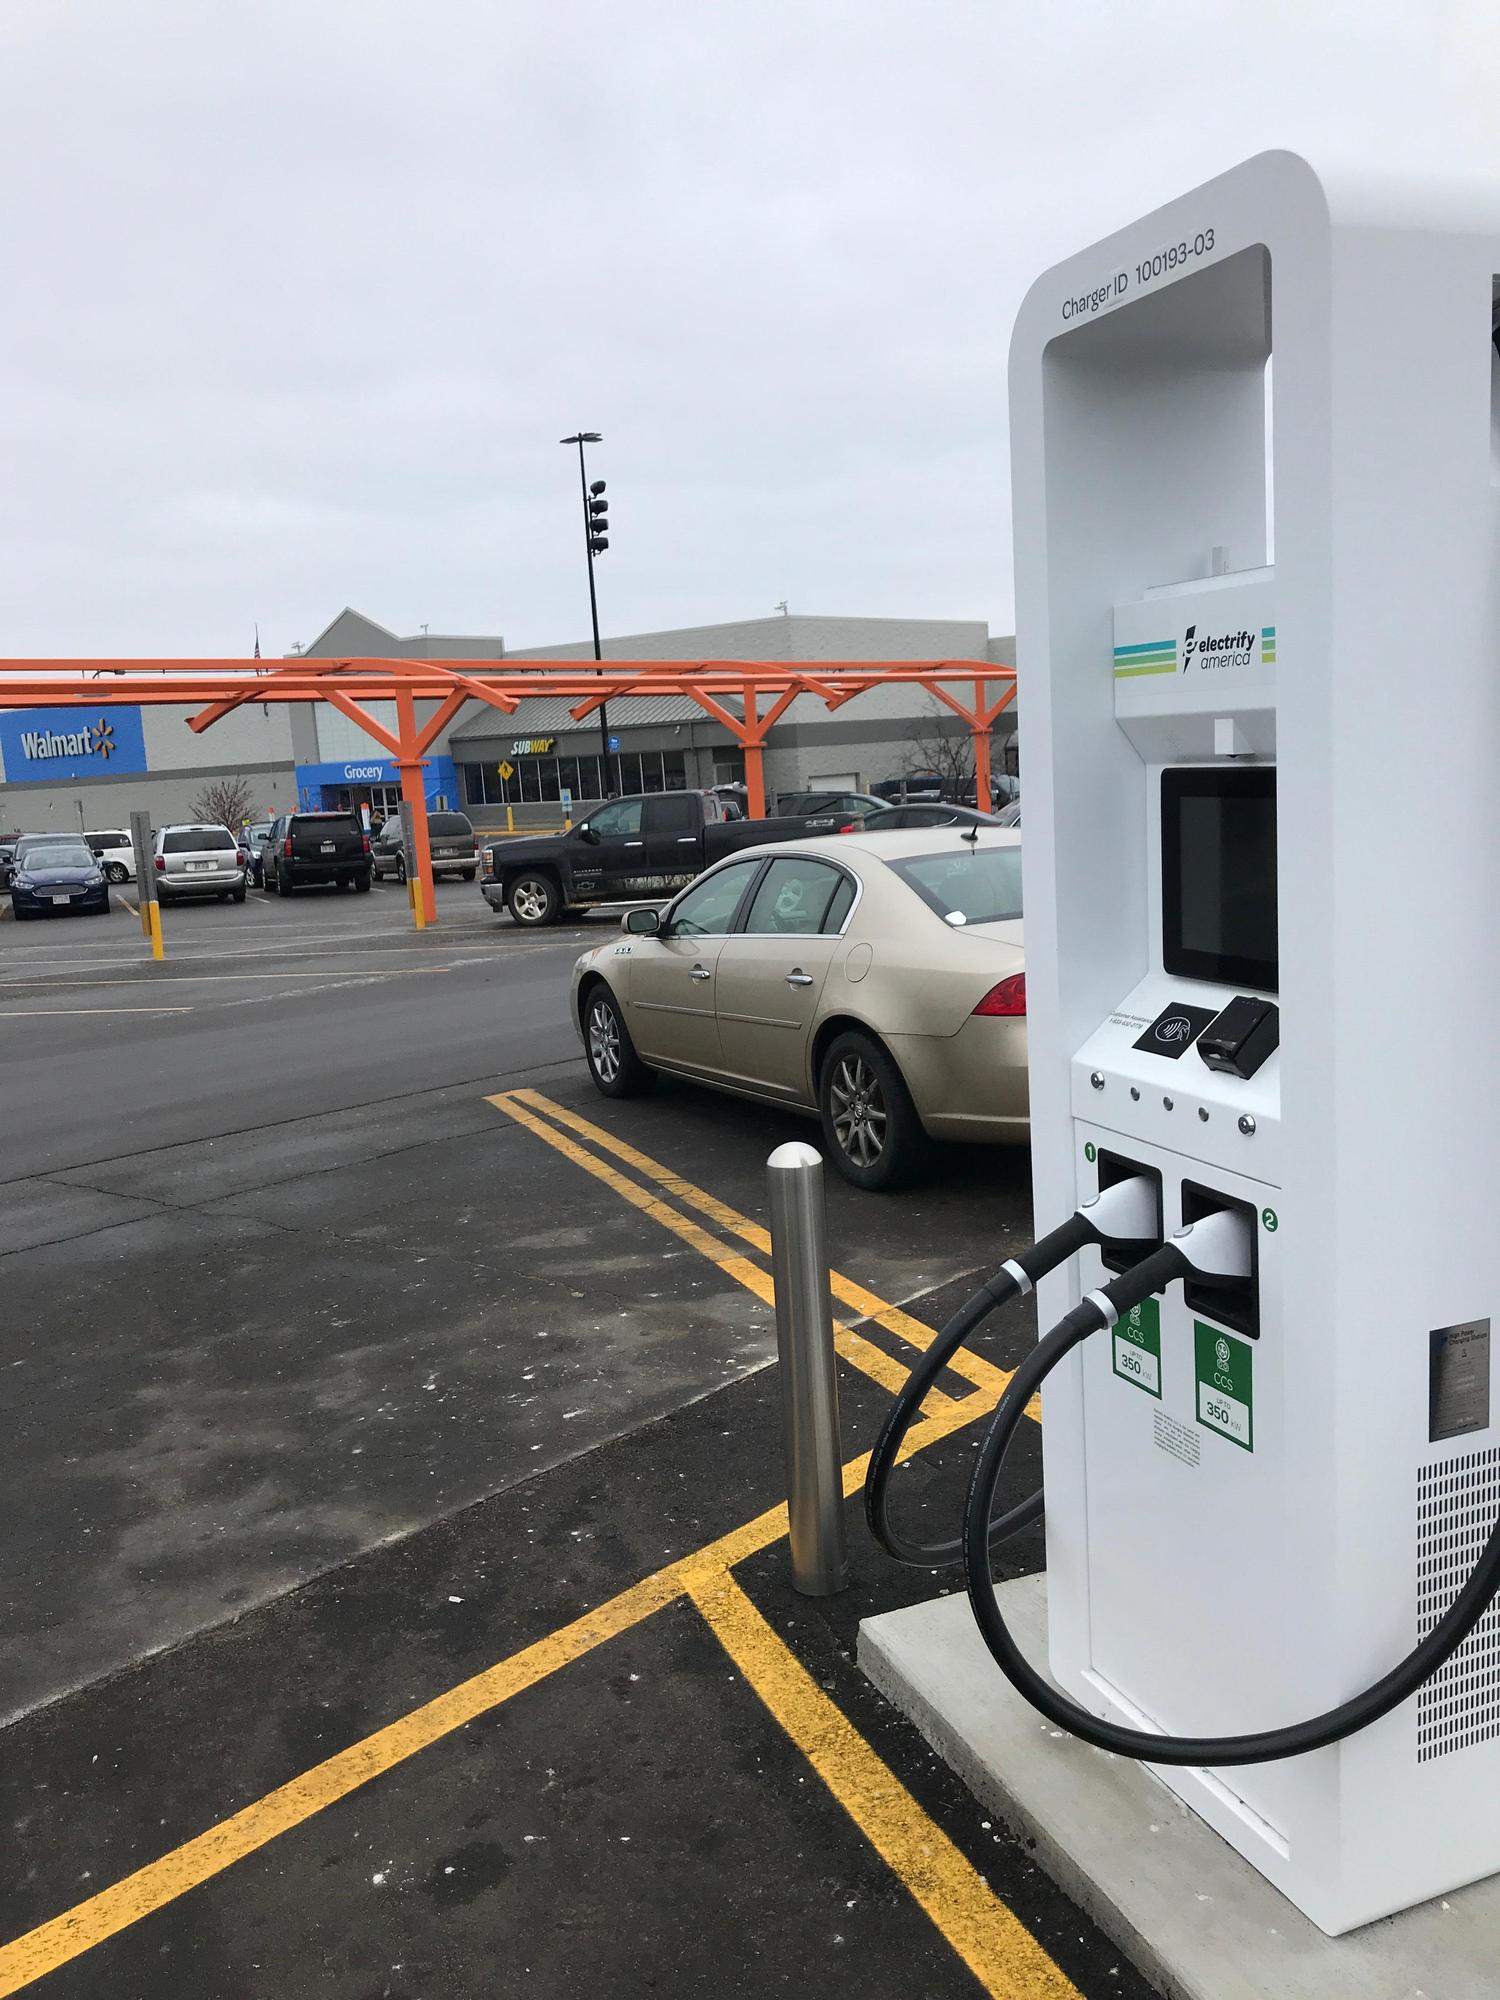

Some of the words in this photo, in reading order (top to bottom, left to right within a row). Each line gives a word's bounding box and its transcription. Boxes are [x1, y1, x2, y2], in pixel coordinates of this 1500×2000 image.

[1062, 284, 1111, 319] Charger
[1114, 273, 1128, 296] ID
[1136, 228, 1215, 284] 100193-03
[1199, 631, 1255, 652] electrify
[1201, 651, 1251, 670] america
[21, 726, 93, 760] Walmart
[511, 737, 555, 756] SUBWAY
[344, 764, 383, 782] Grocery
[1265, 1211, 1275, 1230] 2
[1127, 1326, 1144, 1343] CCS
[1122, 1354, 1141, 1374] 350
[1214, 1372, 1233, 1391] CCS
[1207, 1401, 1229, 1424] 350
